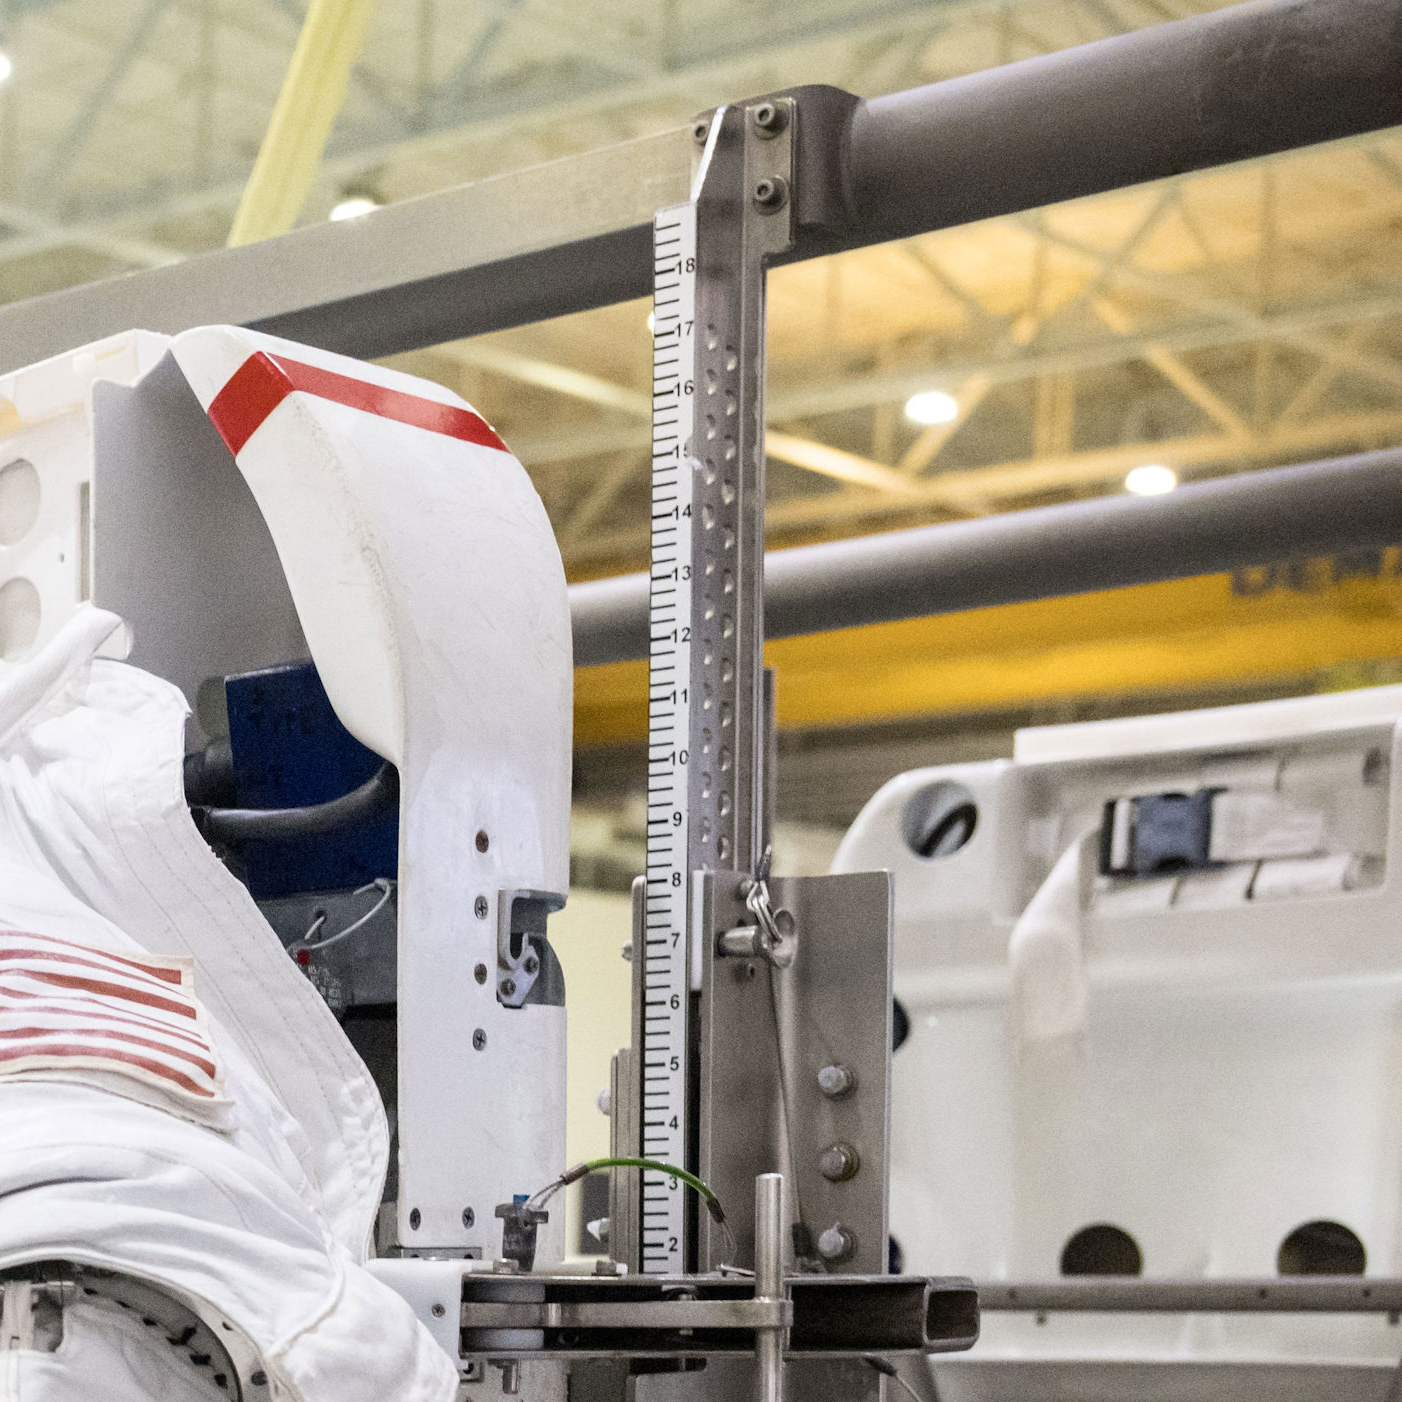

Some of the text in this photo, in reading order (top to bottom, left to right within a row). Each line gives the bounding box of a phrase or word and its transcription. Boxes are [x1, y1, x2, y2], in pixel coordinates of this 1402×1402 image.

[675, 257, 695, 274] 18
[675, 320, 694, 337] 17
[674, 381, 694, 397] 16
[672, 505, 692, 519] 14
[672, 566, 691, 581] 13
[671, 627, 691, 642] 12
[670, 689, 688, 704] 11
[669, 750, 688, 766] 10
[672, 811, 682, 827] 9
[671, 873, 682, 887] 8
[671, 933, 680, 948] 7
[670, 994, 680, 1010] 6
[670, 1055, 680, 1071] 5
[669, 1115, 679, 1130] 4
[669, 1176, 678, 1191] 3
[669, 1237, 678, 1252] 2
